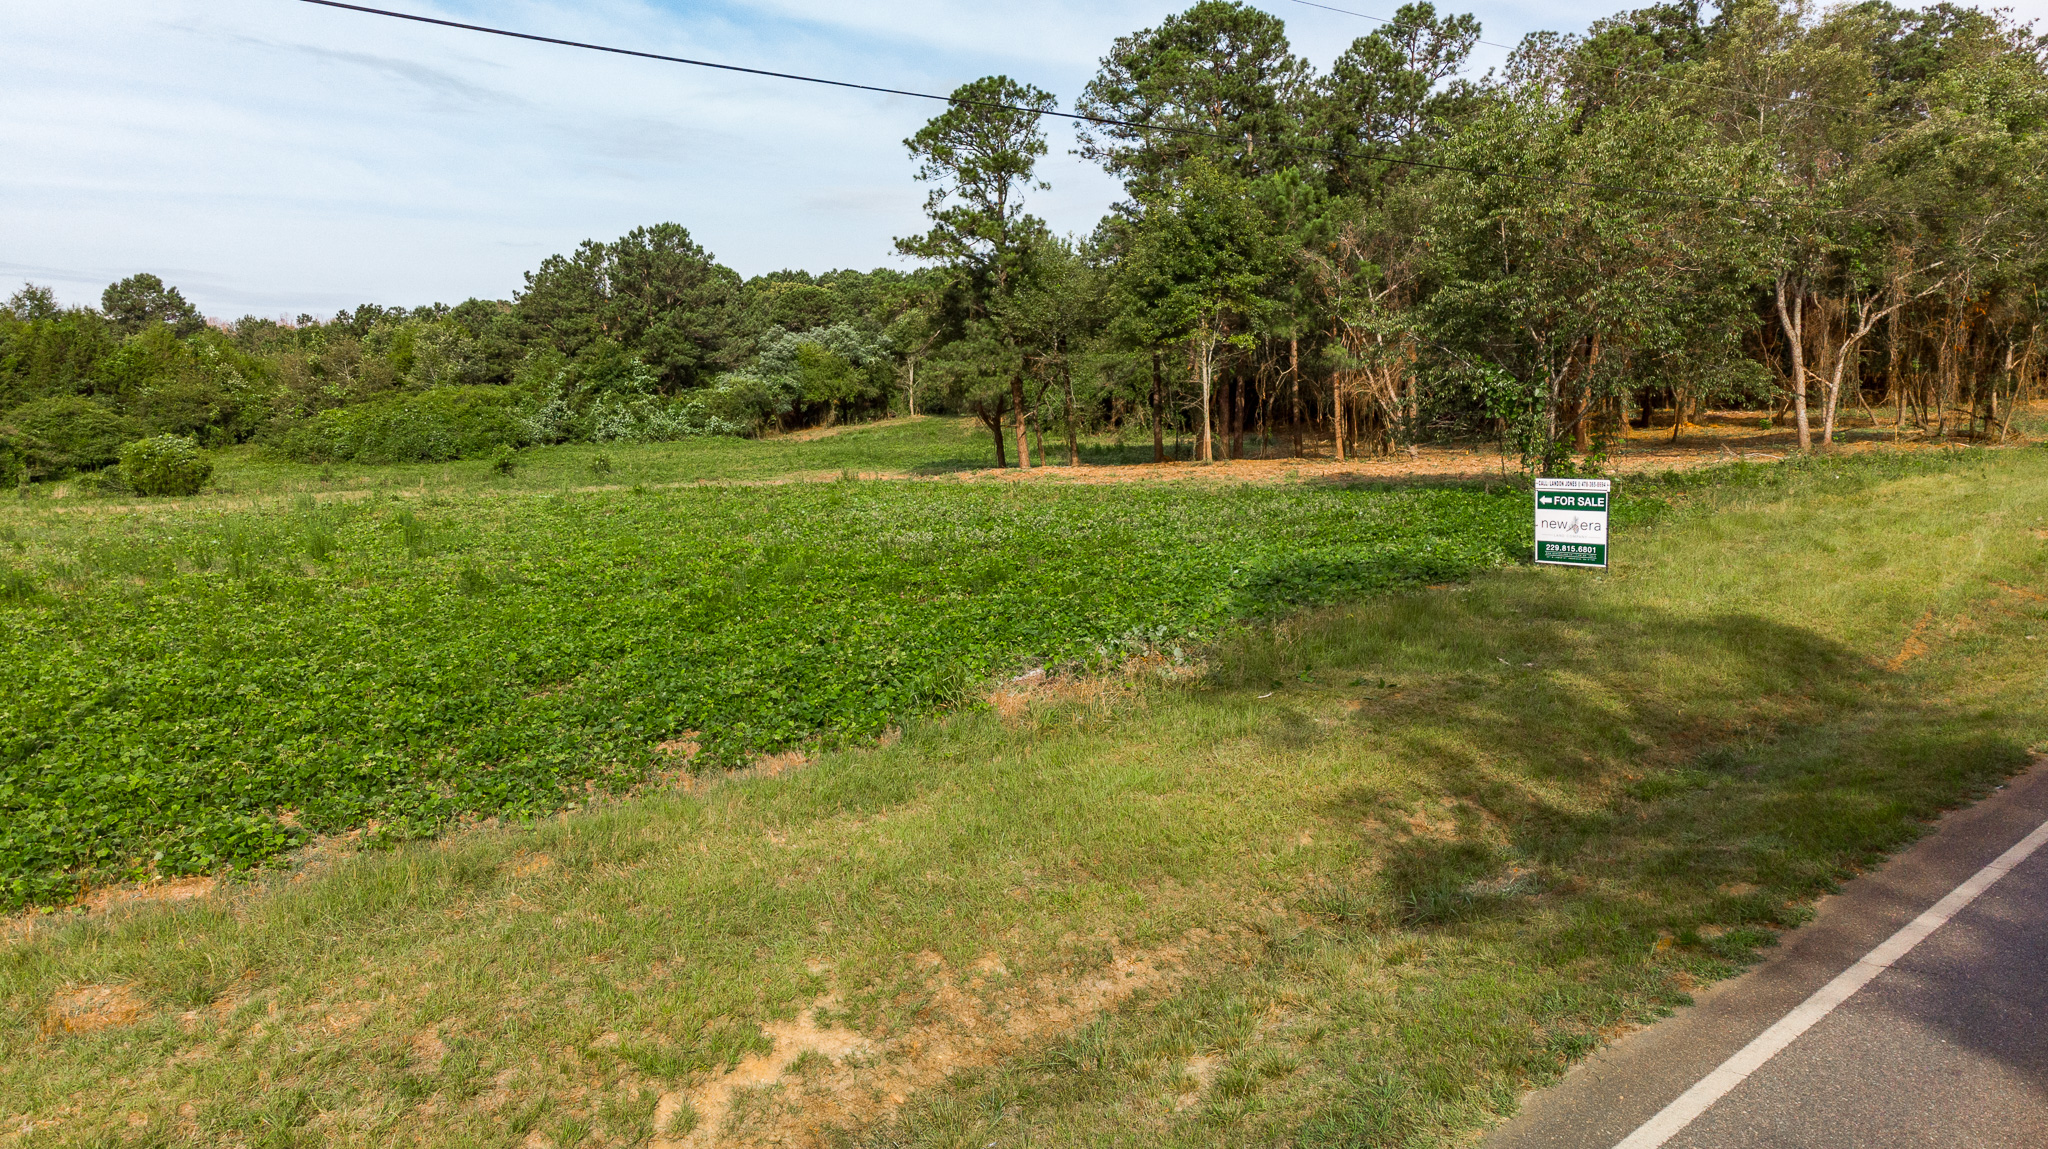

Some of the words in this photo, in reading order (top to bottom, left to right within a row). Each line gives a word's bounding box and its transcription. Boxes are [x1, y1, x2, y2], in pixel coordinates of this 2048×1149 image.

[1554, 496, 1575, 506] FOR
[1577, 497, 1605, 507] SALE
[1541, 519, 1568, 530] new
[1580, 521, 1601, 531] era
[1545, 544, 1597, 553] 229.815.6801
